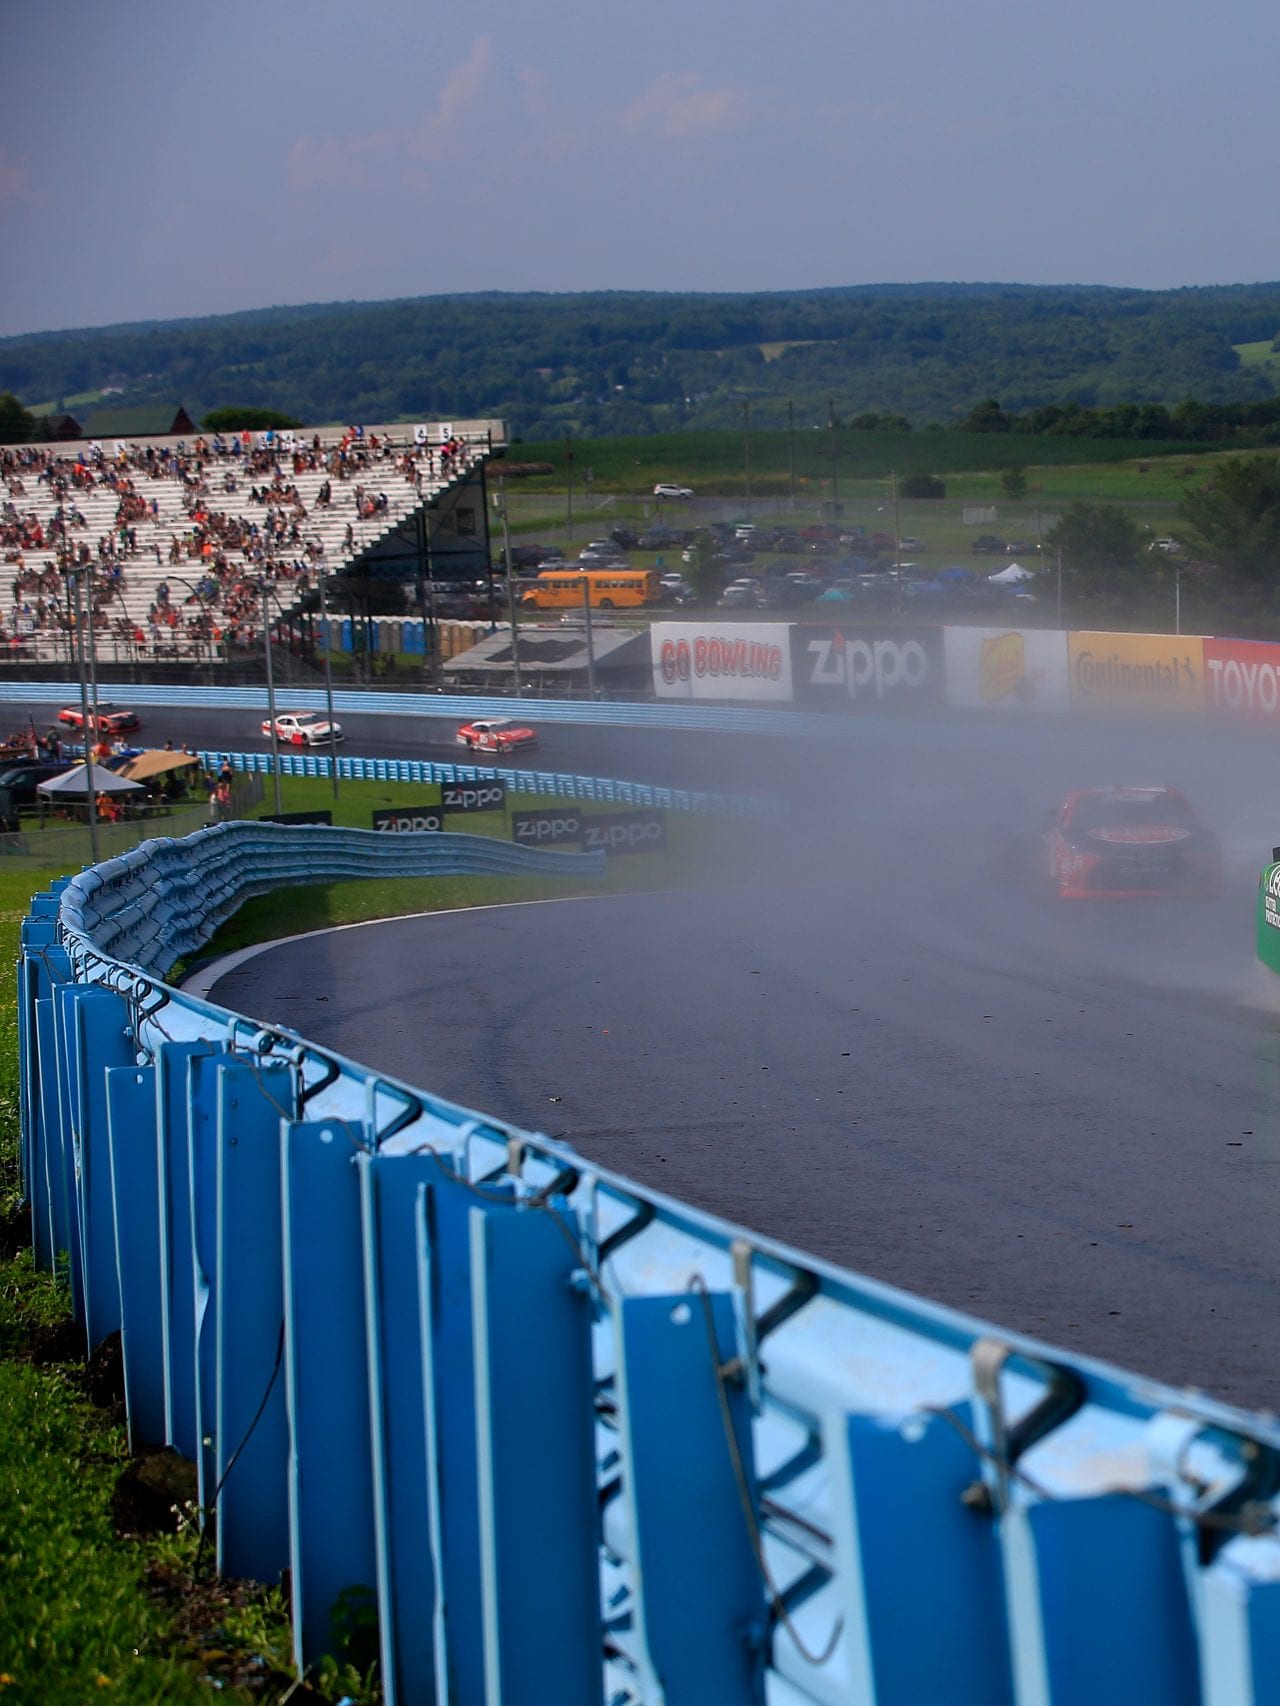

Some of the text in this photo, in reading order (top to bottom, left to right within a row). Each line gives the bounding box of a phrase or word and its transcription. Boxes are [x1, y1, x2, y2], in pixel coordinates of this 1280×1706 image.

[661, 636, 782, 684] GO BOWLING
[1076, 652, 1179, 695] Continental
